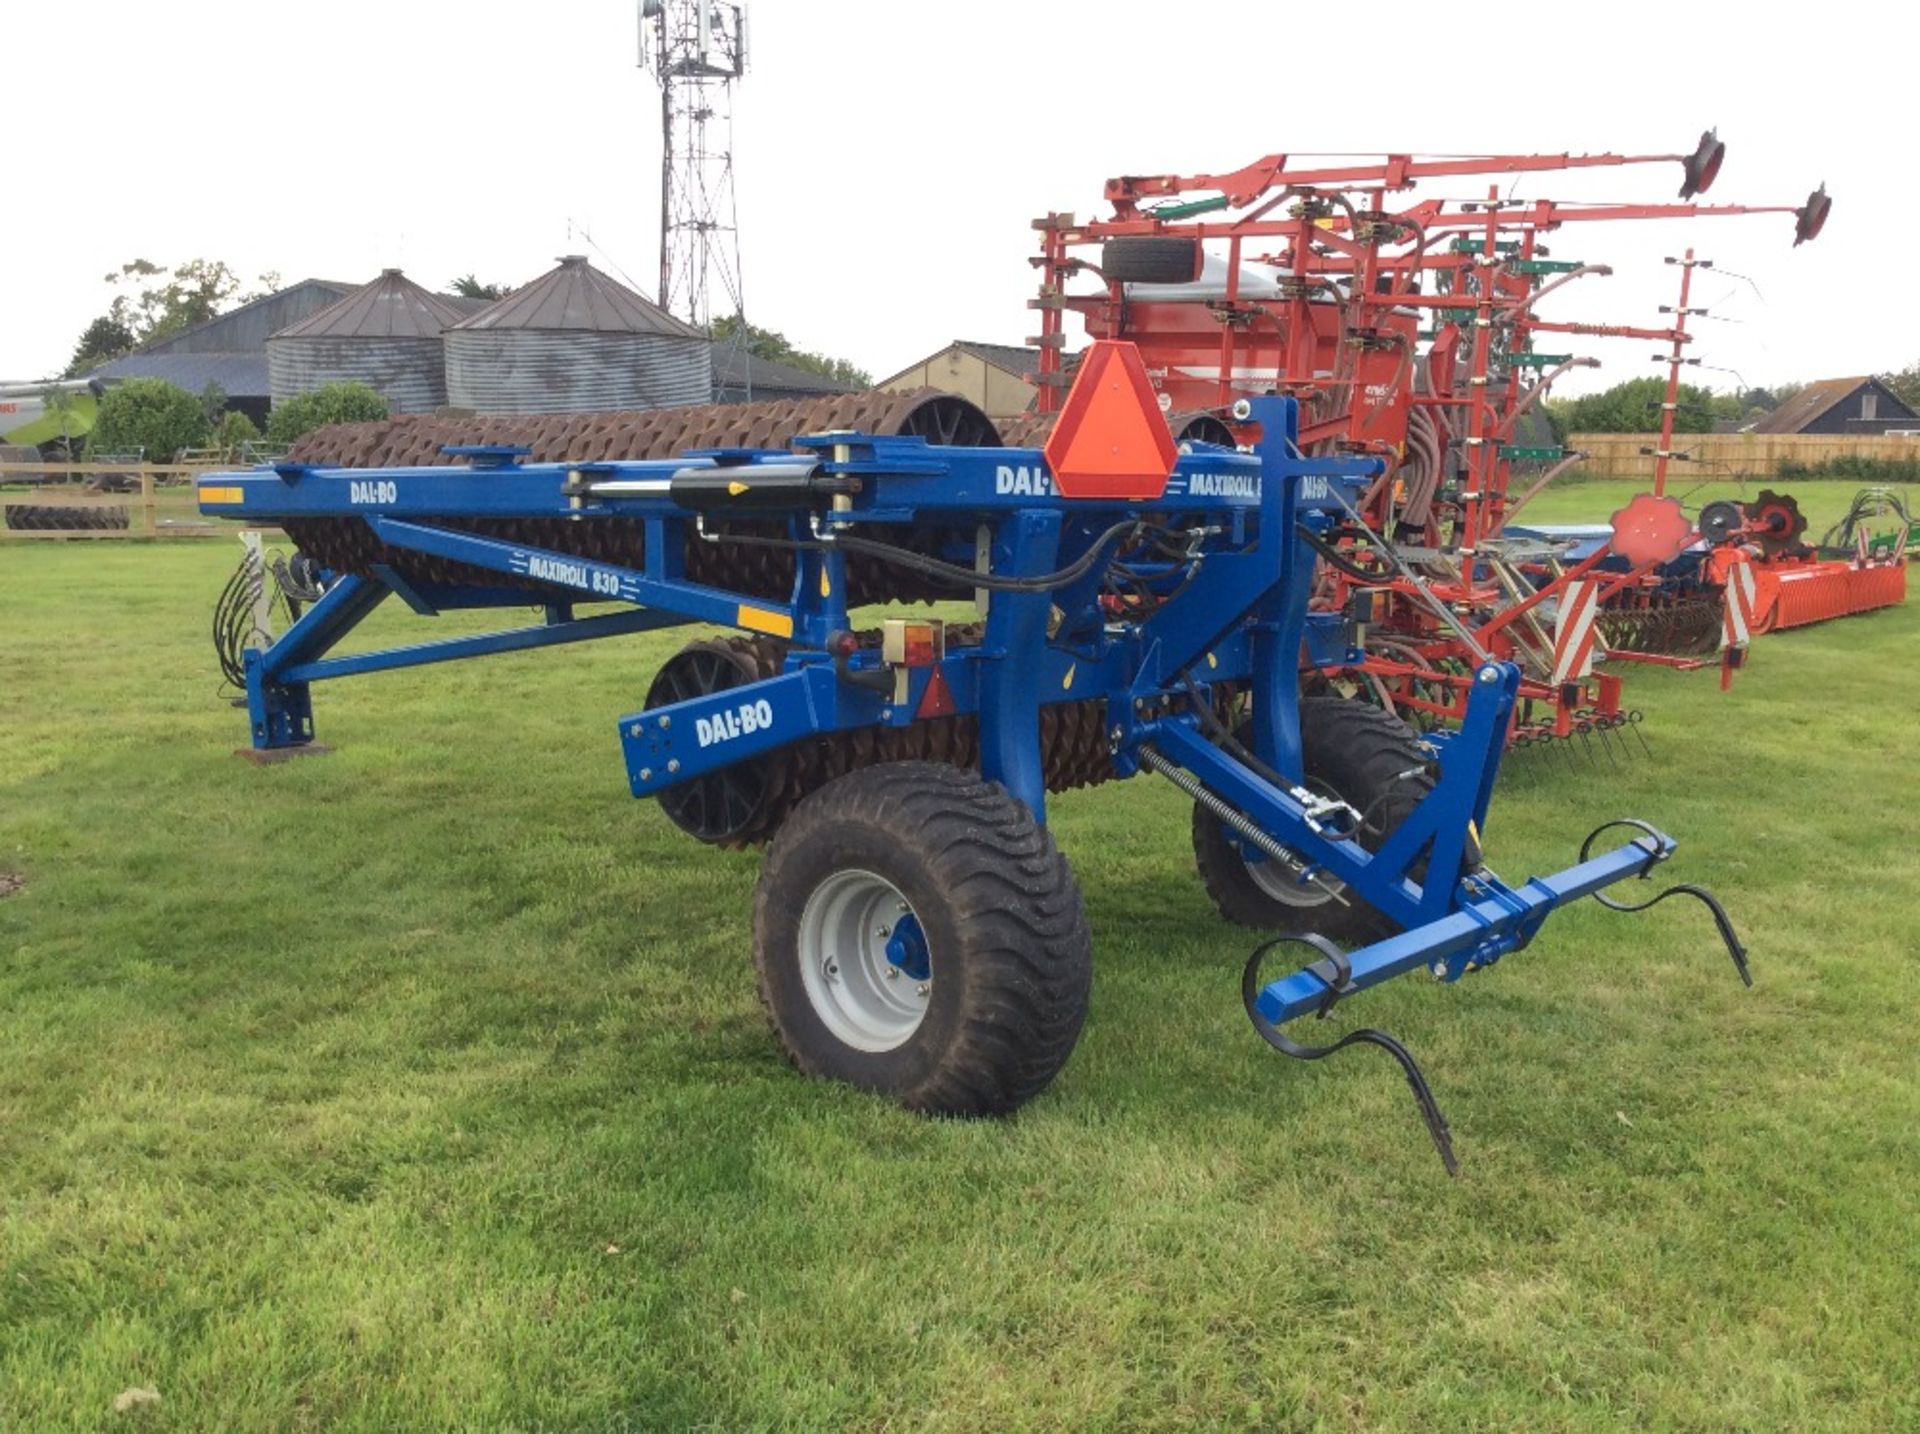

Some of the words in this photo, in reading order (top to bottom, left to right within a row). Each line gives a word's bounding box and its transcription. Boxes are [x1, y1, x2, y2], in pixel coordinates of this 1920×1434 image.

[1189, 473, 1254, 497] MAXIROLL
[529, 556, 588, 589] MAXIROLL
[592, 571, 619, 596] 830
